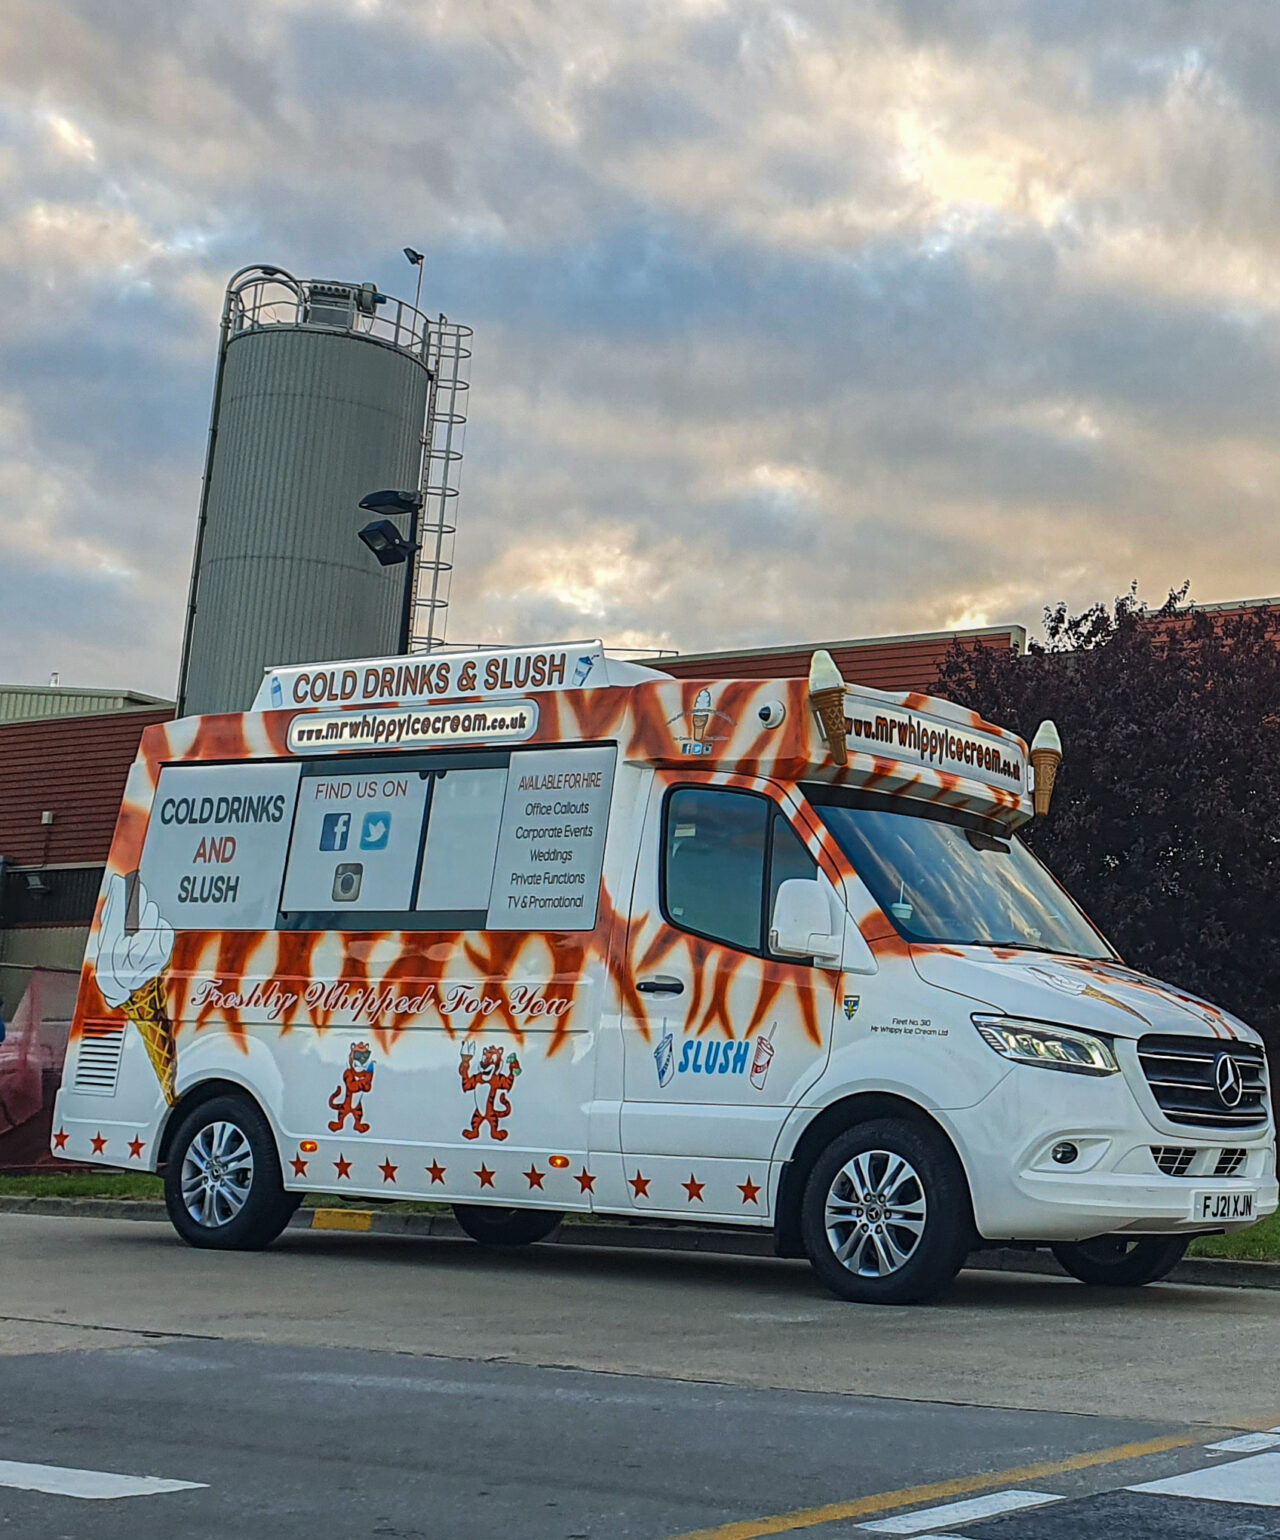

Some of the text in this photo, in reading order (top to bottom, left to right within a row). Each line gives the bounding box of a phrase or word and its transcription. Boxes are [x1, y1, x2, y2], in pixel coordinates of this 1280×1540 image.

[293, 653, 567, 704] COLD DRINKS & SLUSH
[297, 712, 527, 744] www.mrwhippyicecream.co.uk
[315, 780, 408, 800] FIND US ON
[518, 772, 603, 791] AVAILABLE FOR HIRE
[160, 795, 285, 825] COLD DRINKS
[525, 801, 589, 816] Office Callouts
[515, 824, 593, 841] Corporate Events
[193, 836, 236, 864] AND
[530, 848, 573, 864] Weddings
[178, 875, 239, 903] SLUSH
[510, 871, 585, 885] Private Functions
[508, 894, 584, 909] TV & Promotional
[191, 979, 575, 1025] Freshly Whipped For You
[880, 1026, 902, 1035] Whippy
[914, 1027, 937, 1036] Cream
[678, 1040, 750, 1074] SLUSH
[1203, 1194, 1252, 1218] FJ21 XJN
